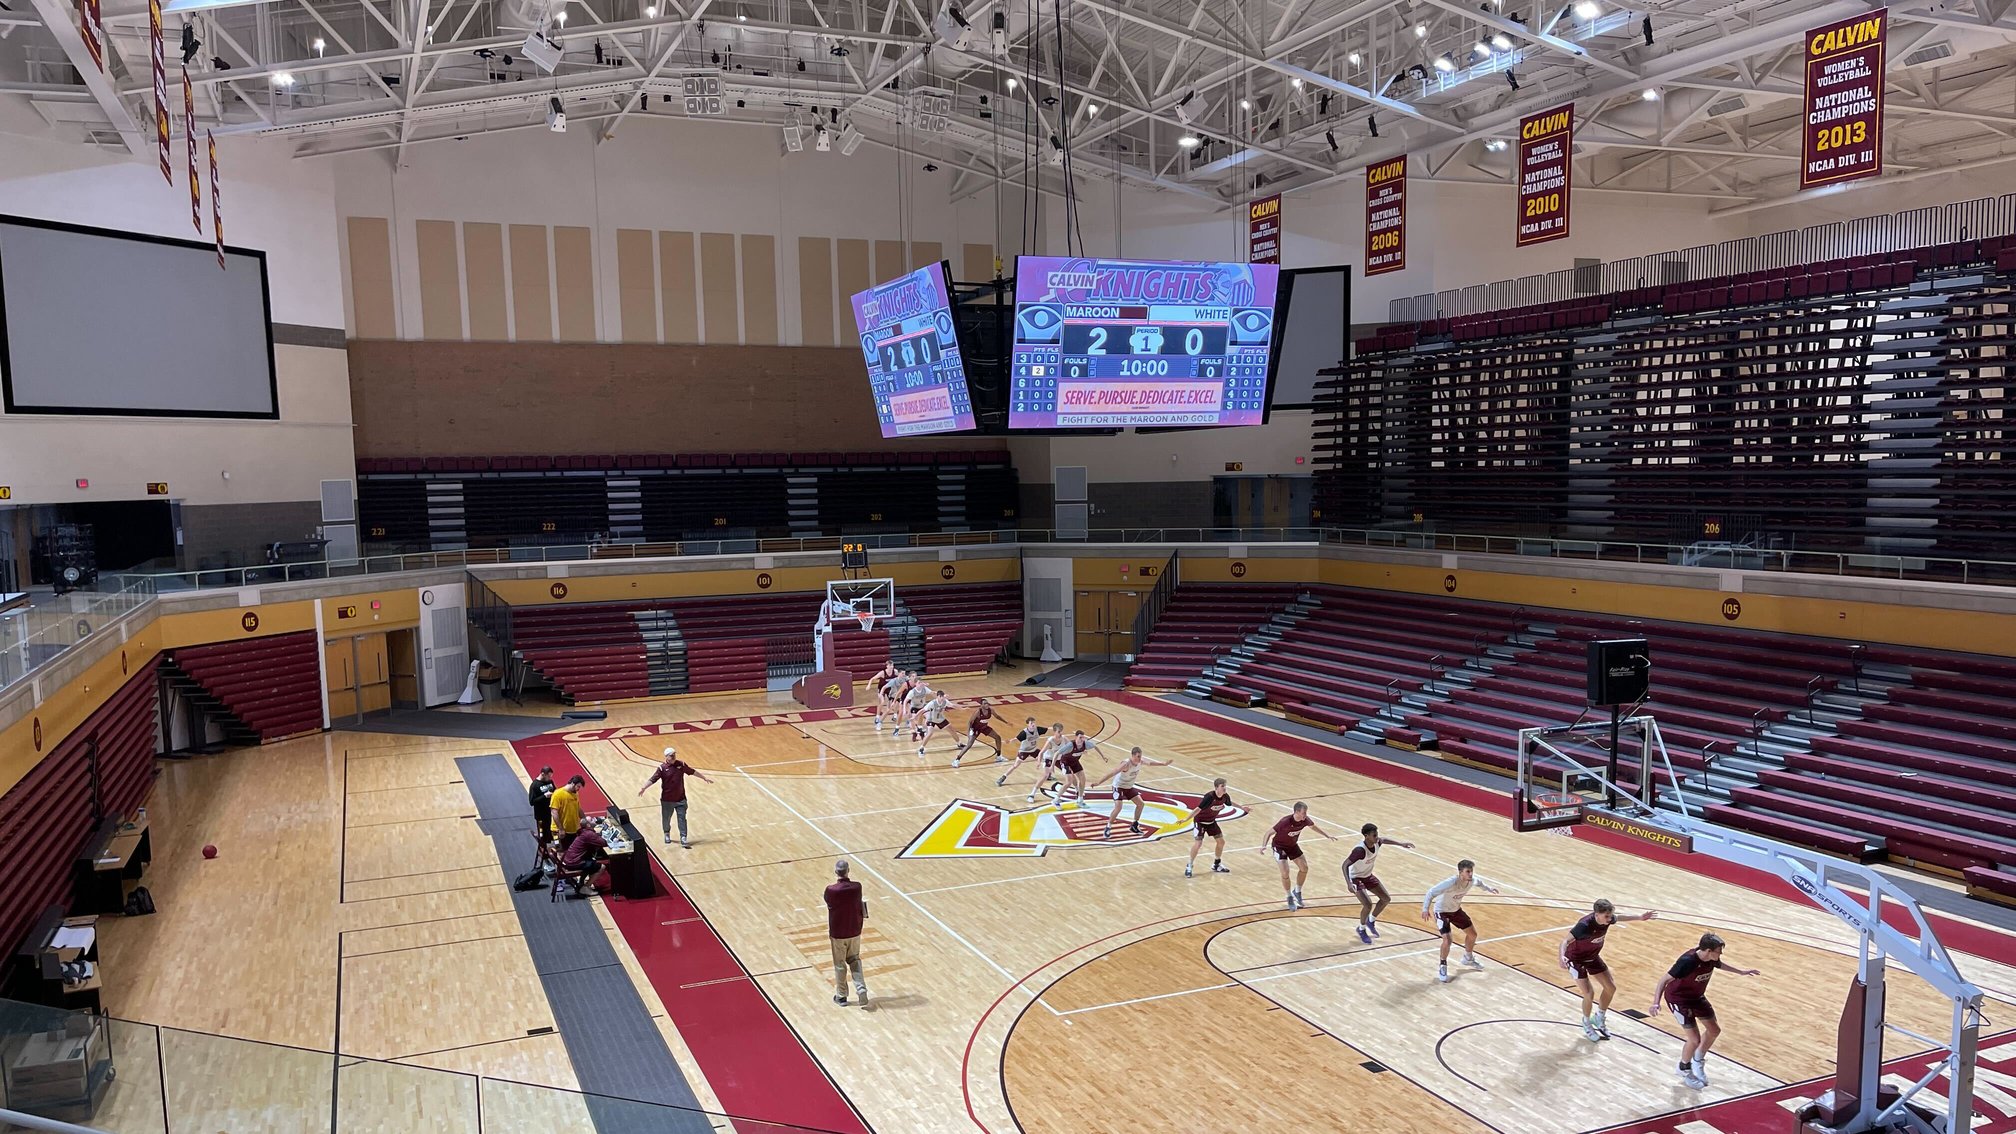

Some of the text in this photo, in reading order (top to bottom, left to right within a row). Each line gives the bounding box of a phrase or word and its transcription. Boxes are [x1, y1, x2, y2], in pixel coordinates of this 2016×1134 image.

[1810, 17, 1881, 56] CALVIN
[1824, 56, 1865, 75] WOMEN'S
[1817, 66, 1871, 88] VOLLEYBALL
[1815, 86, 1871, 109] NATIONAL
[1809, 99, 1876, 125] CHAMPIONS
[1523, 110, 1569, 139] CALVIN
[1817, 121, 1866, 151] 2013
[1531, 141, 1559, 155] WOMEN'S
[1527, 149, 1563, 166] VOLLEYBALL
[1809, 150, 1873, 173] NCAA DIV. III
[1369, 160, 1404, 184] CALVIN
[1525, 166, 1562, 183] NATIONAL
[1522, 176, 1565, 195] CHAMPIONS
[1251, 199, 1278, 218] CALVIN
[1526, 193, 1559, 216] 2010
[1371, 207, 1400, 222] NATIONAL
[1369, 216, 1402, 231] CHAMPIONS
[1521, 217, 1563, 234] NCAA DIV. III
[1372, 231, 1399, 251] 2006
[1049, 269, 1215, 299] CALVIN KNIGHTS
[879, 281, 921, 319] KNIGHTS
[1066, 307, 1119, 318] MAROON
[1195, 308, 1228, 319] WHITE
[1088, 327, 1107, 355] 2
[1141, 337, 1150, 352] 1
[1185, 328, 1203, 355] 0
[887, 347, 898, 371] 2
[921, 337, 930, 364] 0
[1020, 367, 1026, 375] 4
[1071, 366, 1079, 378] 0
[1120, 359, 1168, 376] 10:00
[1207, 366, 1214, 377] 0
[1230, 367, 1237, 375] 2
[1019, 379, 1025, 387] 6
[1229, 379, 1235, 387] 3
[1019, 391, 1024, 399] 1
[1228, 390, 1234, 398] 4
[1017, 403, 1024, 411] 2
[1062, 416, 1089, 424] FIGHT
[371, 528, 385, 536] 221
[1704, 523, 1719, 533] 206
[943, 568, 954, 576] 102
[759, 577, 770, 585] 101
[1445, 579, 1455, 588] 104
[553, 587, 564, 595] 116
[1724, 603, 1738, 614] 105
[245, 617, 256, 627] 115
[562, 689, 1093, 741] CALVIN KGHTS
[1587, 815, 1682, 848] CALVIN KNIGHTS
[1792, 875, 1861, 926] SNR SPORTS
